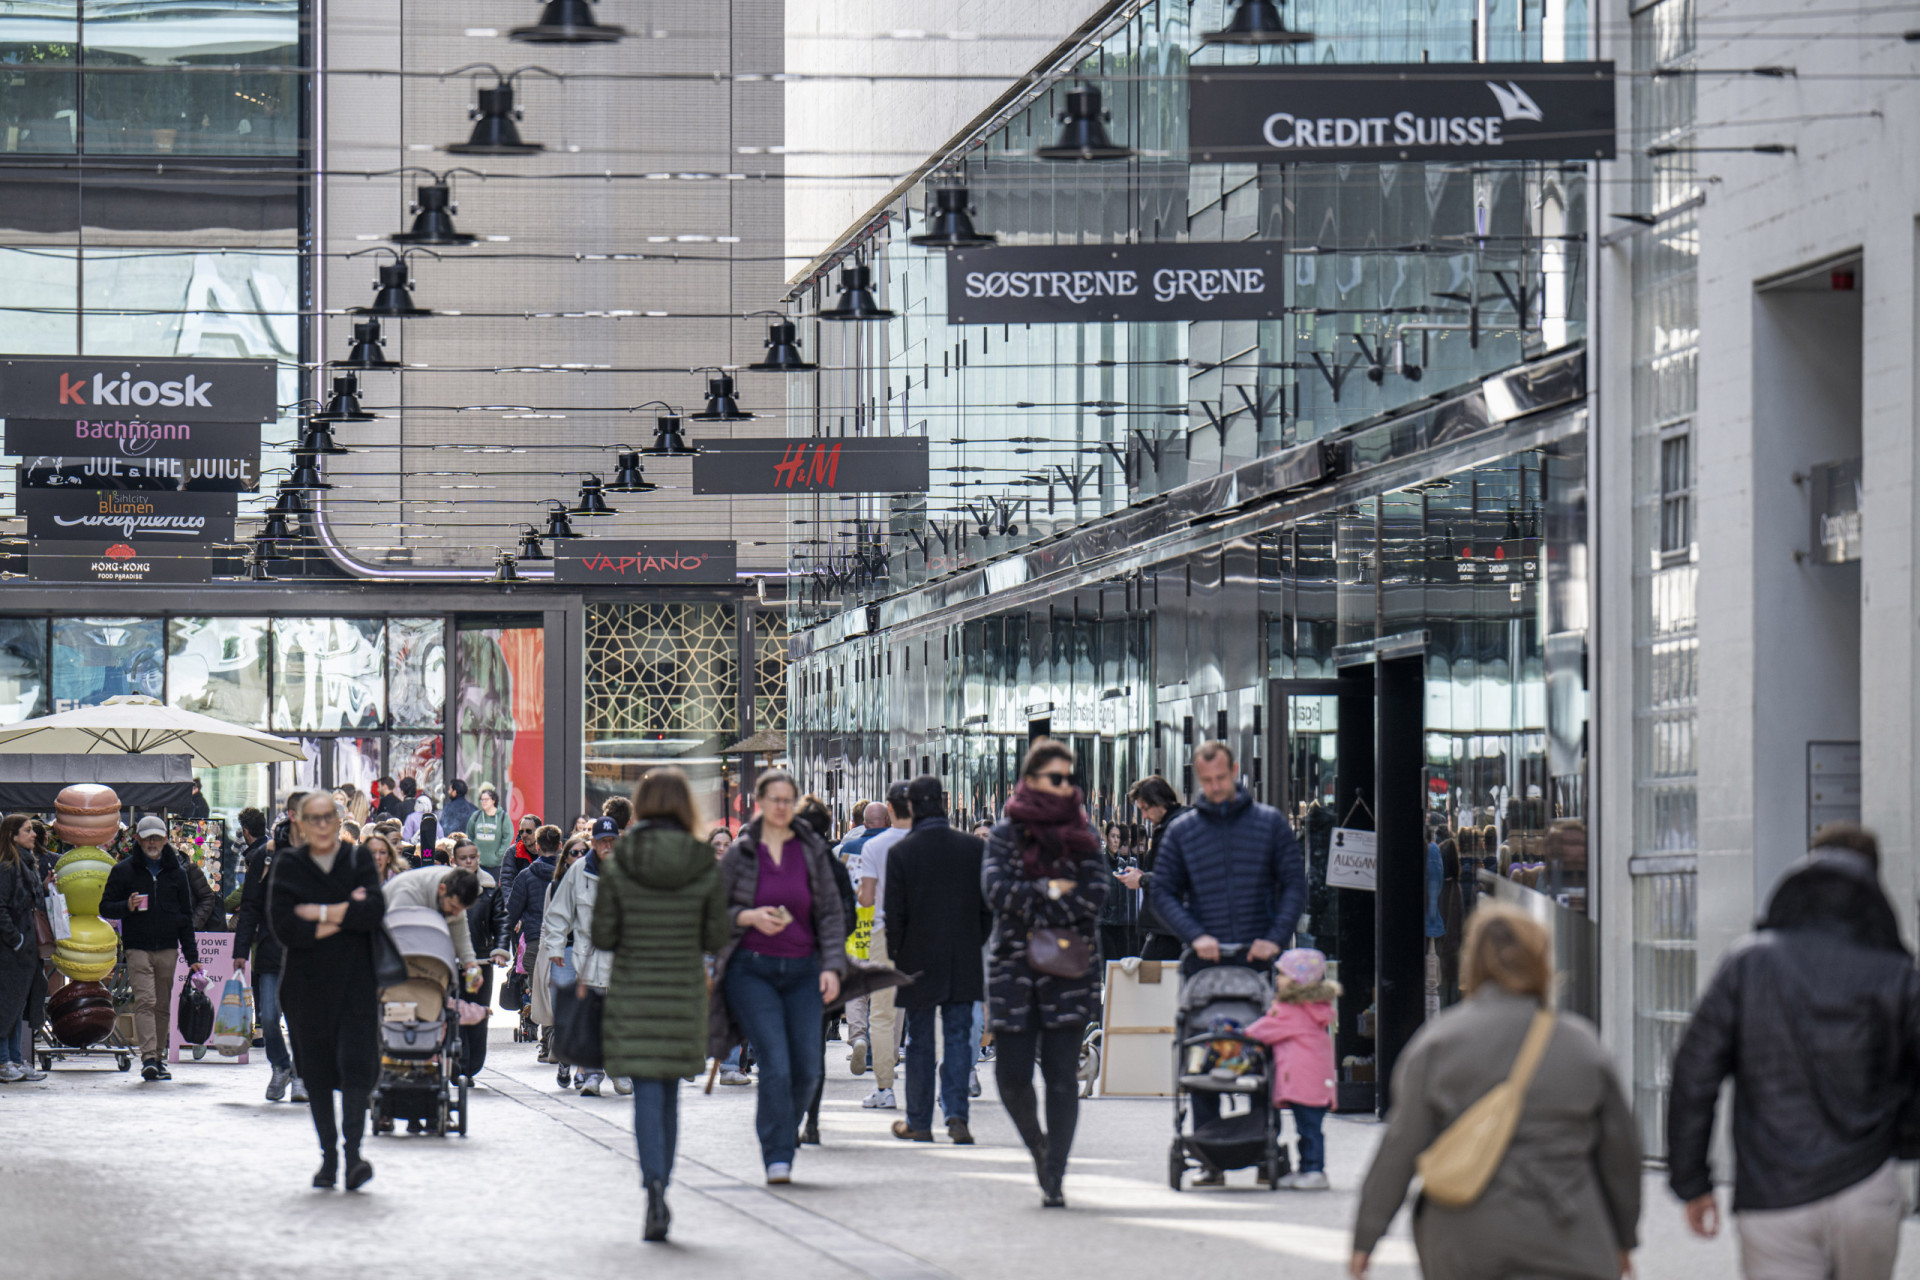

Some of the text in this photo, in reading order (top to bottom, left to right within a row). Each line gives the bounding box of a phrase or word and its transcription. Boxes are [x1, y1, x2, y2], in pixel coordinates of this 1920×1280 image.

[1262, 111, 1503, 148] CREDIT SUISSE
[965, 267, 1266, 304] SØSTRENE GRENE
[59, 371, 213, 407] k kiosk
[75, 419, 190, 440] Bachmann
[128, 467, 141, 478] &
[773, 442, 843, 489] H&M
[99, 494, 154, 514] Blumen
[114, 493, 149, 505] Sihlcity
[91, 562, 150, 572] HONG-KONG
[200, 938, 214, 946] DO
[215, 938, 228, 946] WE
[201, 947, 220, 955] OUR
